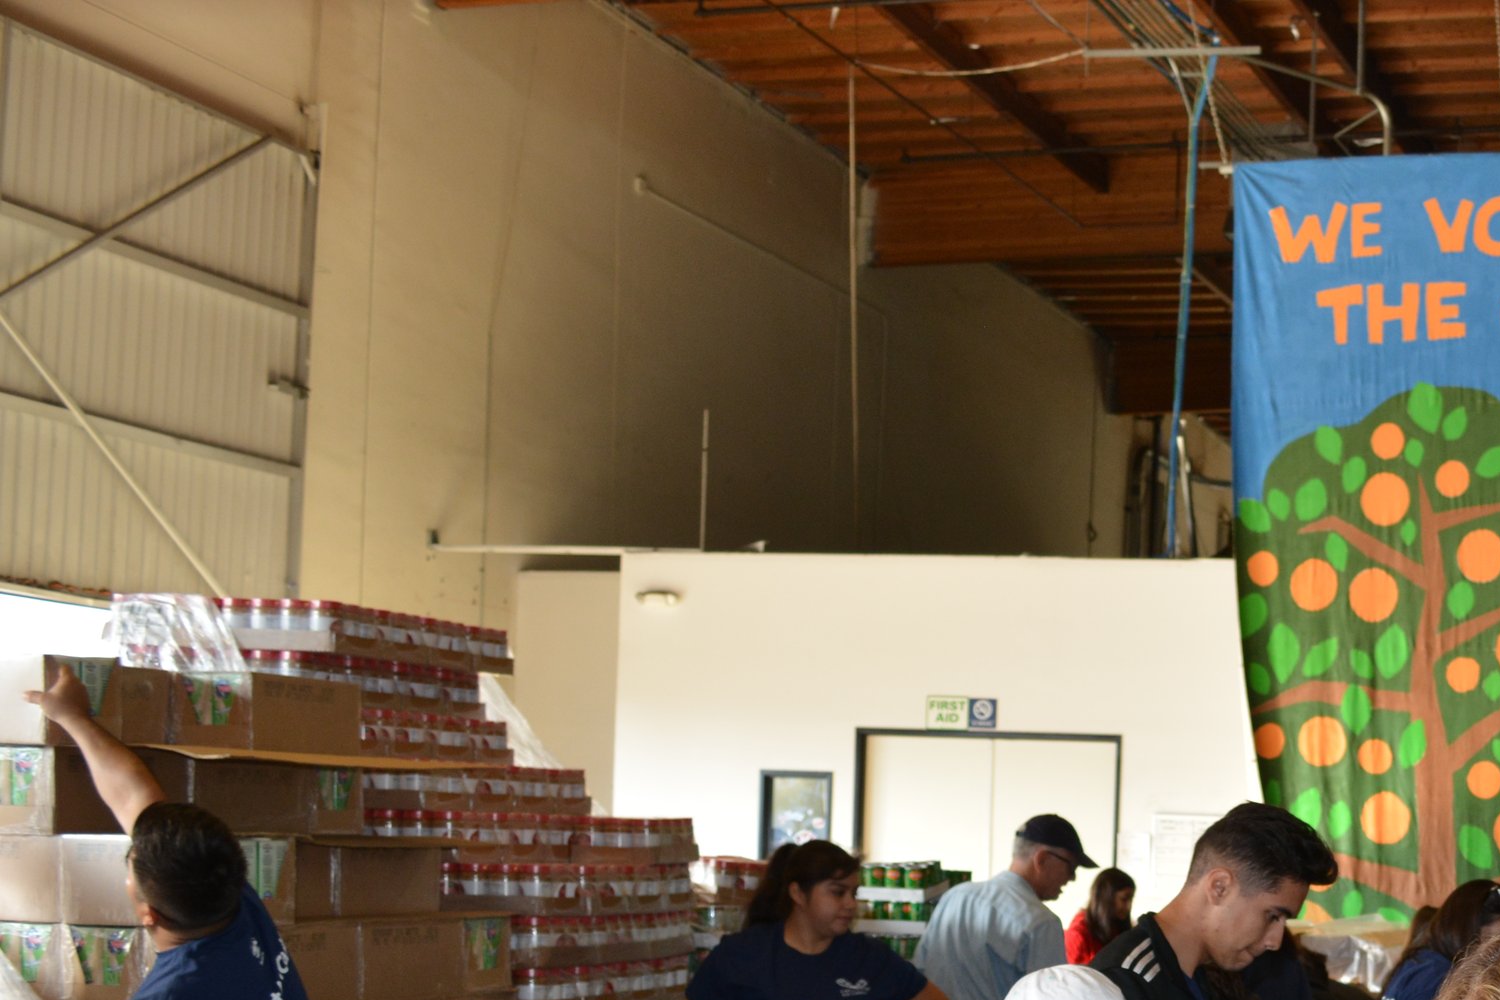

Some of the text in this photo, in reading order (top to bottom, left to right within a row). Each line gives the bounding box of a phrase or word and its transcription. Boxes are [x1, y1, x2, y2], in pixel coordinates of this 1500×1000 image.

[1268, 200, 1385, 263] WE
[1315, 280, 1467, 346] THE
[928, 700, 966, 711] FIRST
[936, 712, 961, 723] AID
